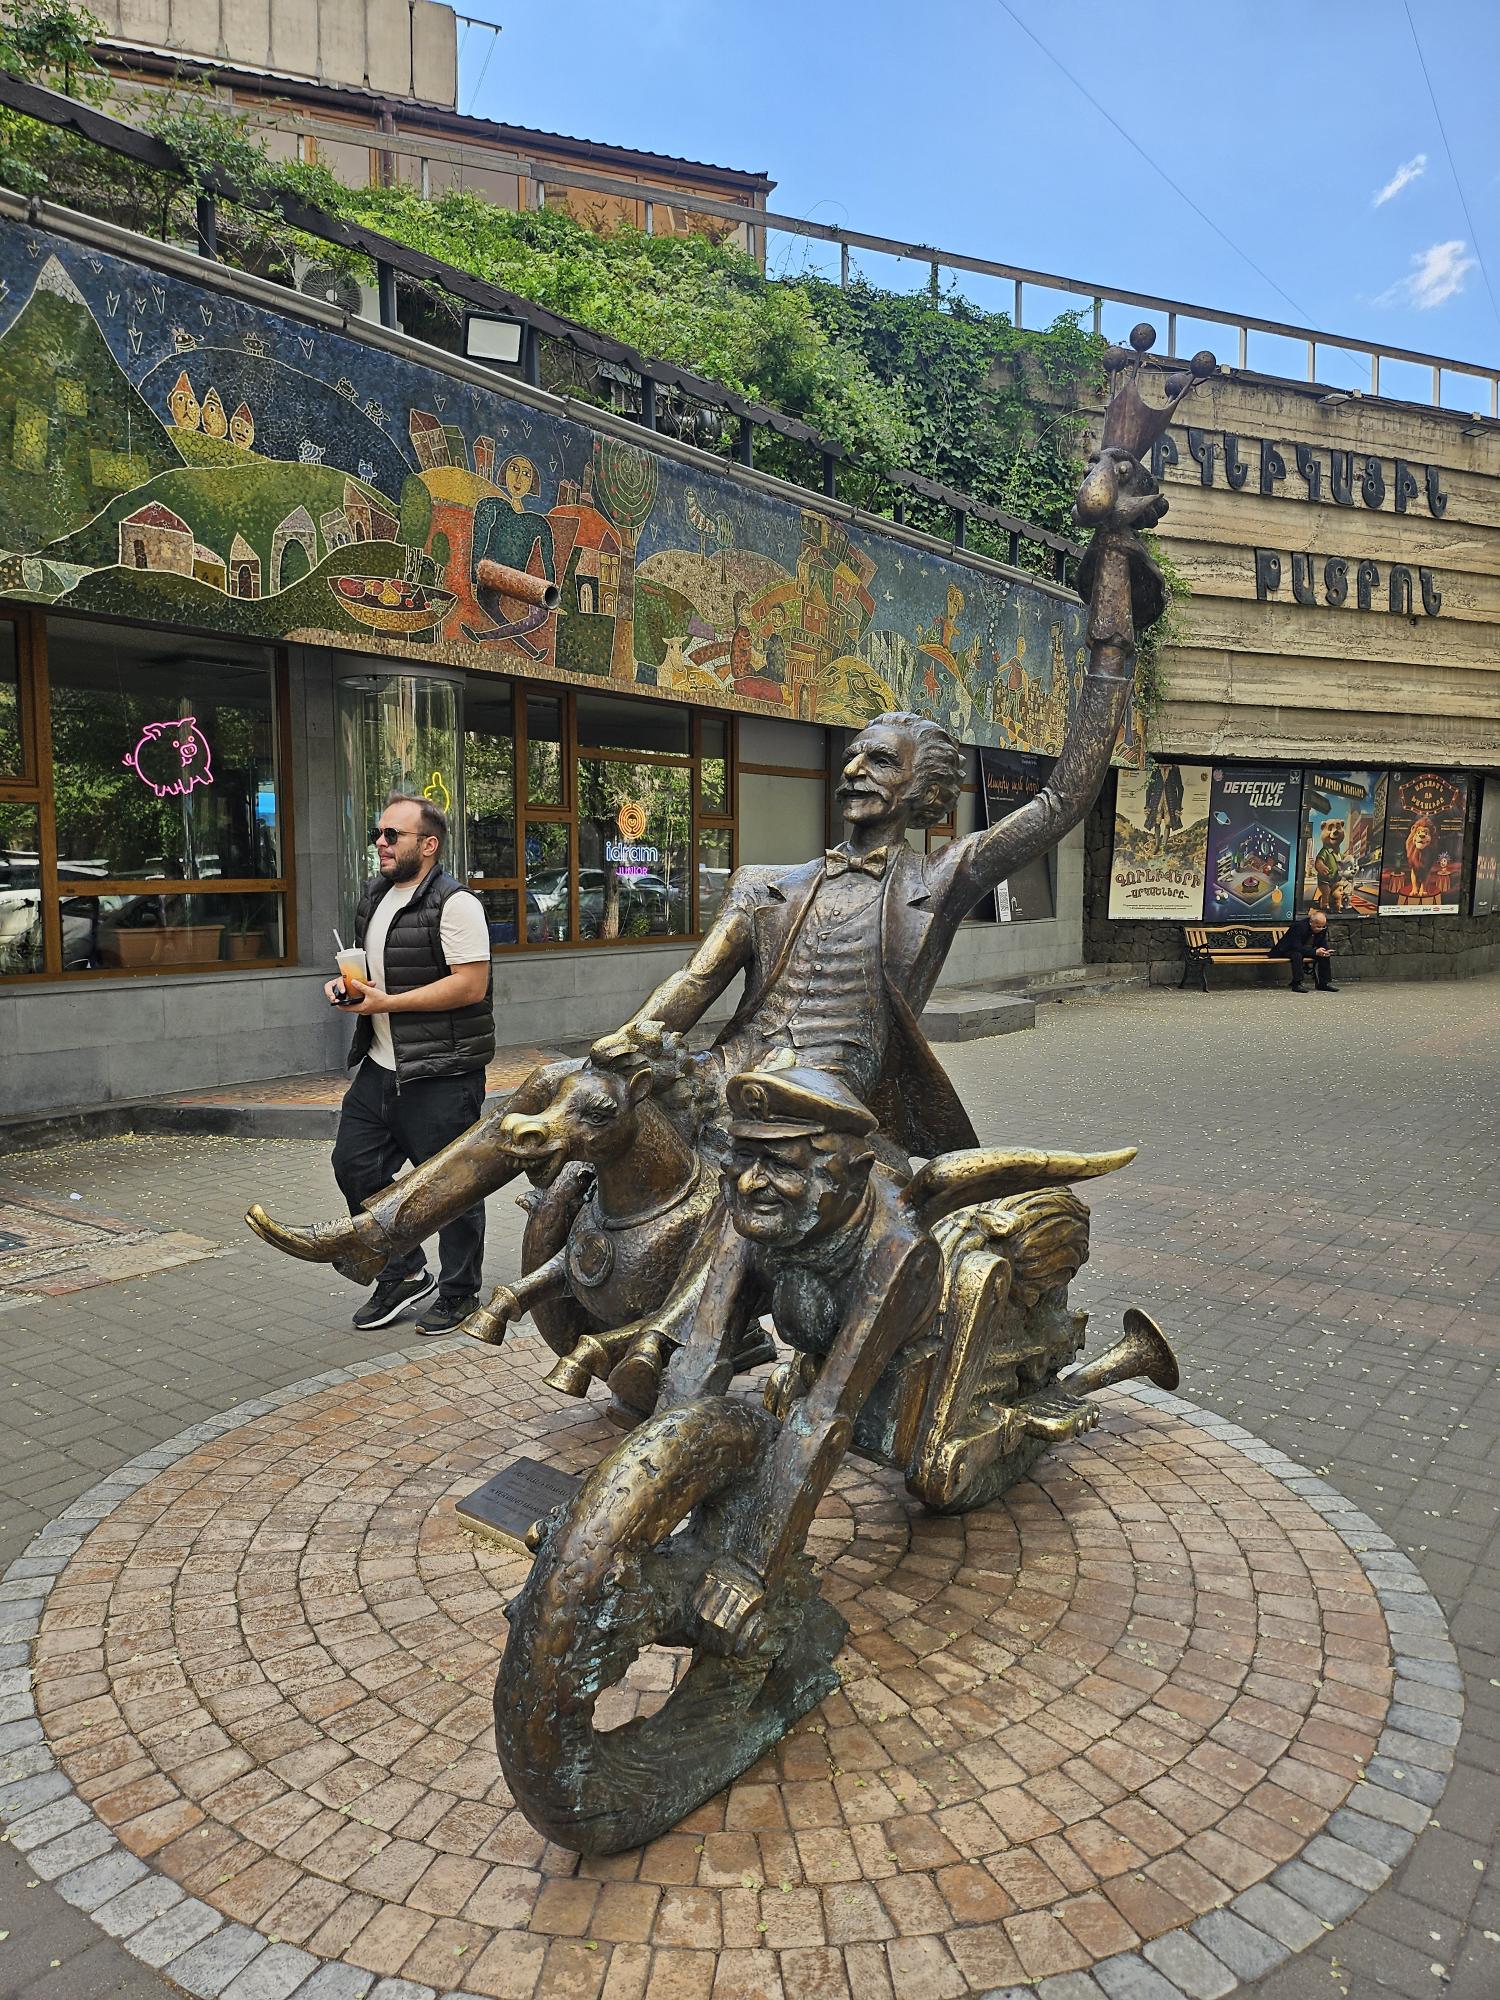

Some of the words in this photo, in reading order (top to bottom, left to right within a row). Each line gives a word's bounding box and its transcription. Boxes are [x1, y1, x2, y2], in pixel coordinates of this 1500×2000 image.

[1150, 427, 1448, 518] ԻԿՆԻԿԱՅԻՆ
[1254, 547, 1443, 617] ԹԱՏՐՈՆ
[1223, 781, 1286, 794] DETECTIVE
[1249, 793, 1283, 808] ԱԼԵՆ
[605, 840, 658, 861] idram
[615, 866, 648, 876] JUNIOR
